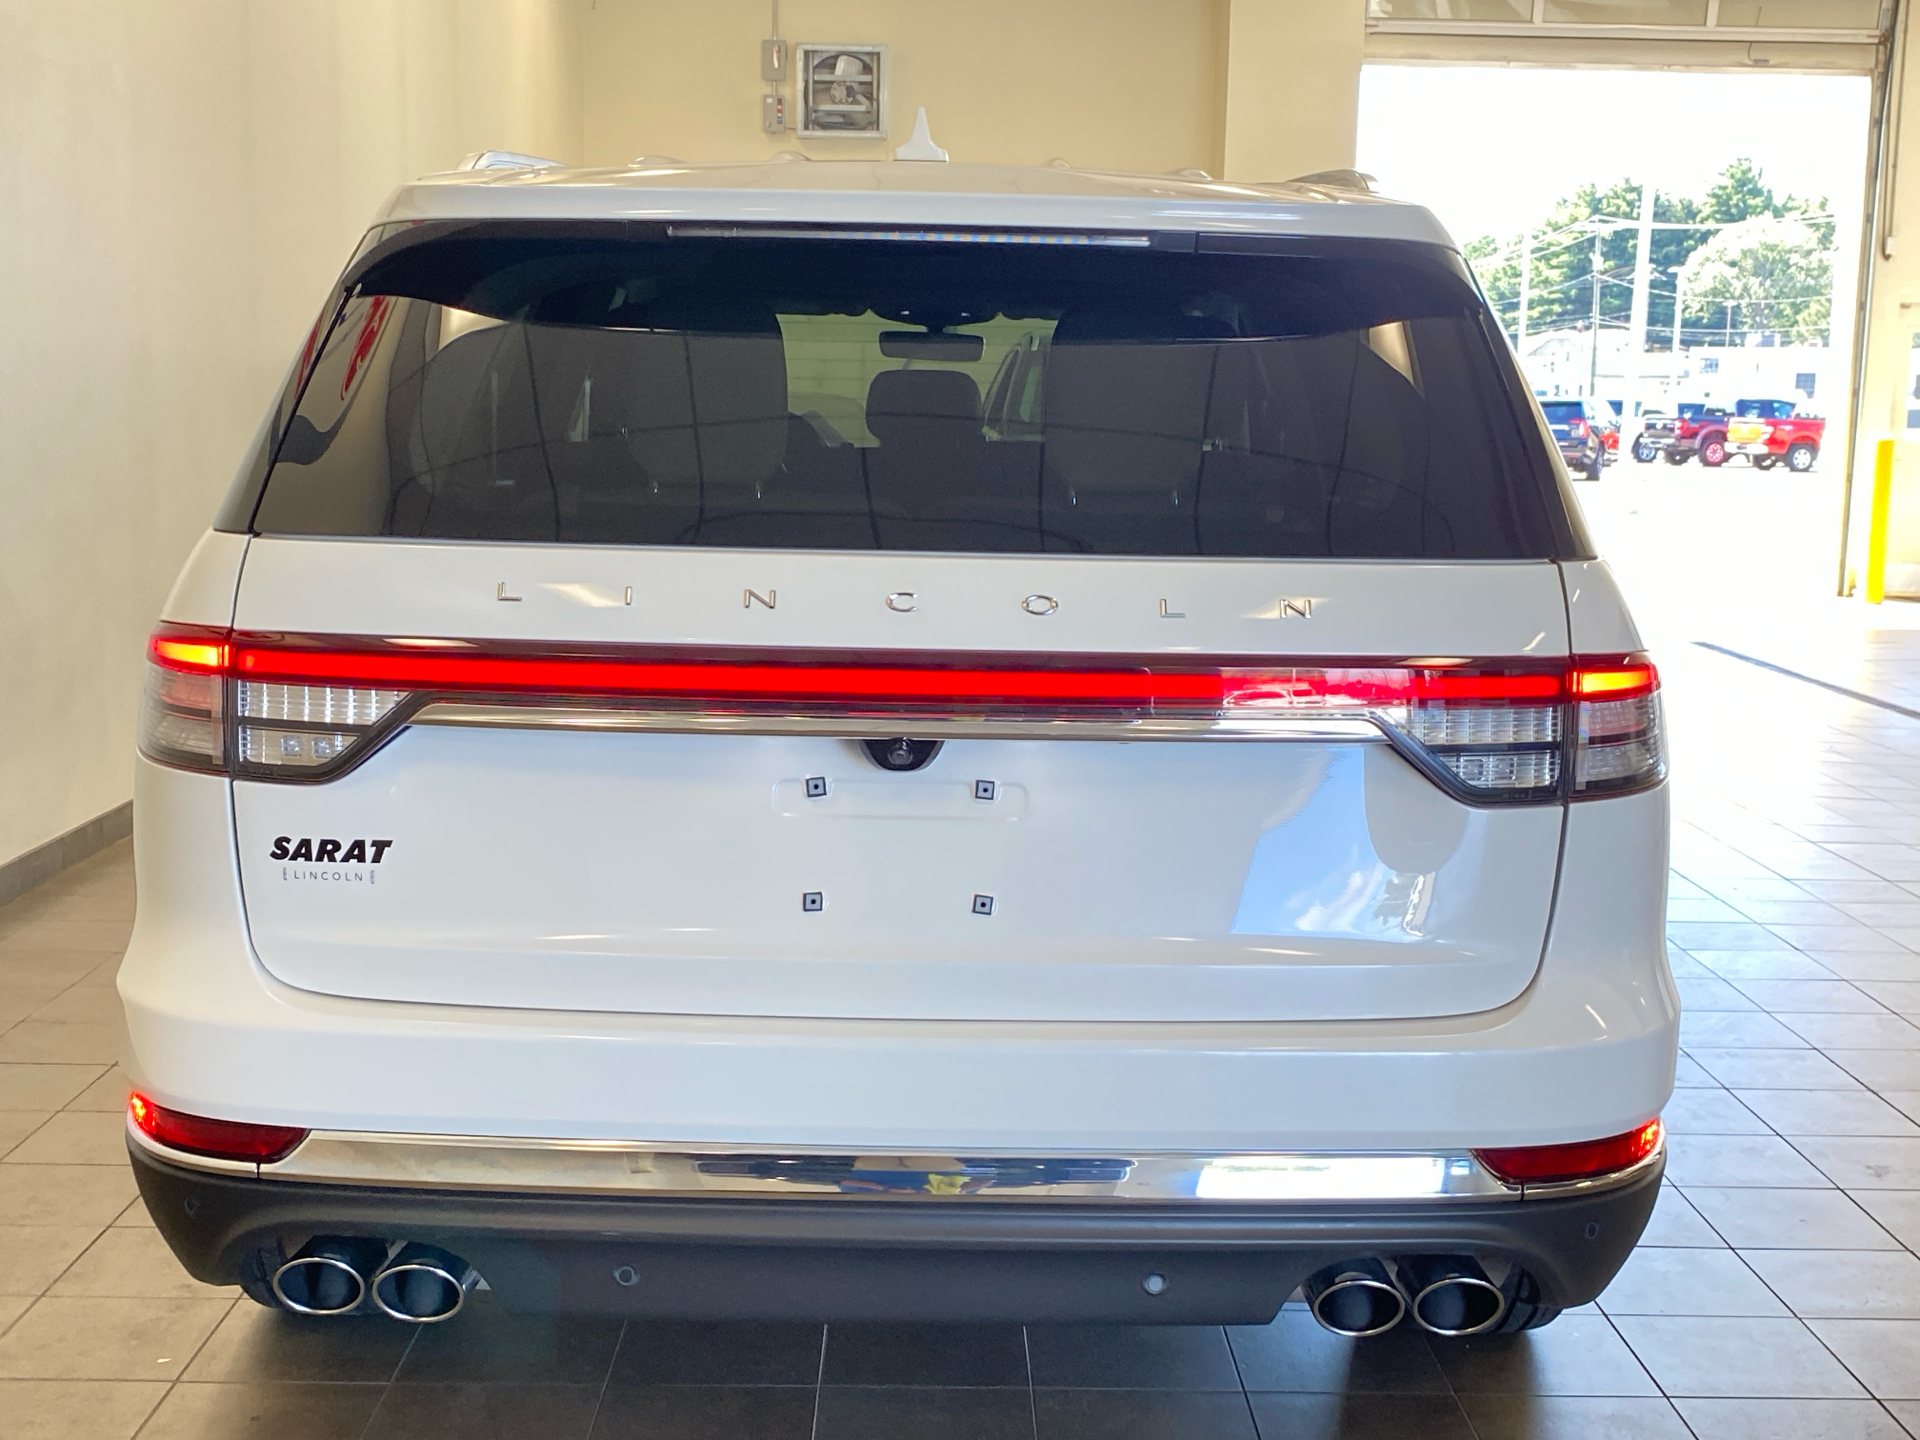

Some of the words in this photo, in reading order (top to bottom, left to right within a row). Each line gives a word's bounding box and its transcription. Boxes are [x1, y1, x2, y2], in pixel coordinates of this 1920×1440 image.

[497, 581, 1312, 619] LINCOLN
[269, 836, 393, 864] SARAT
[293, 870, 363, 882] LINCOLN
